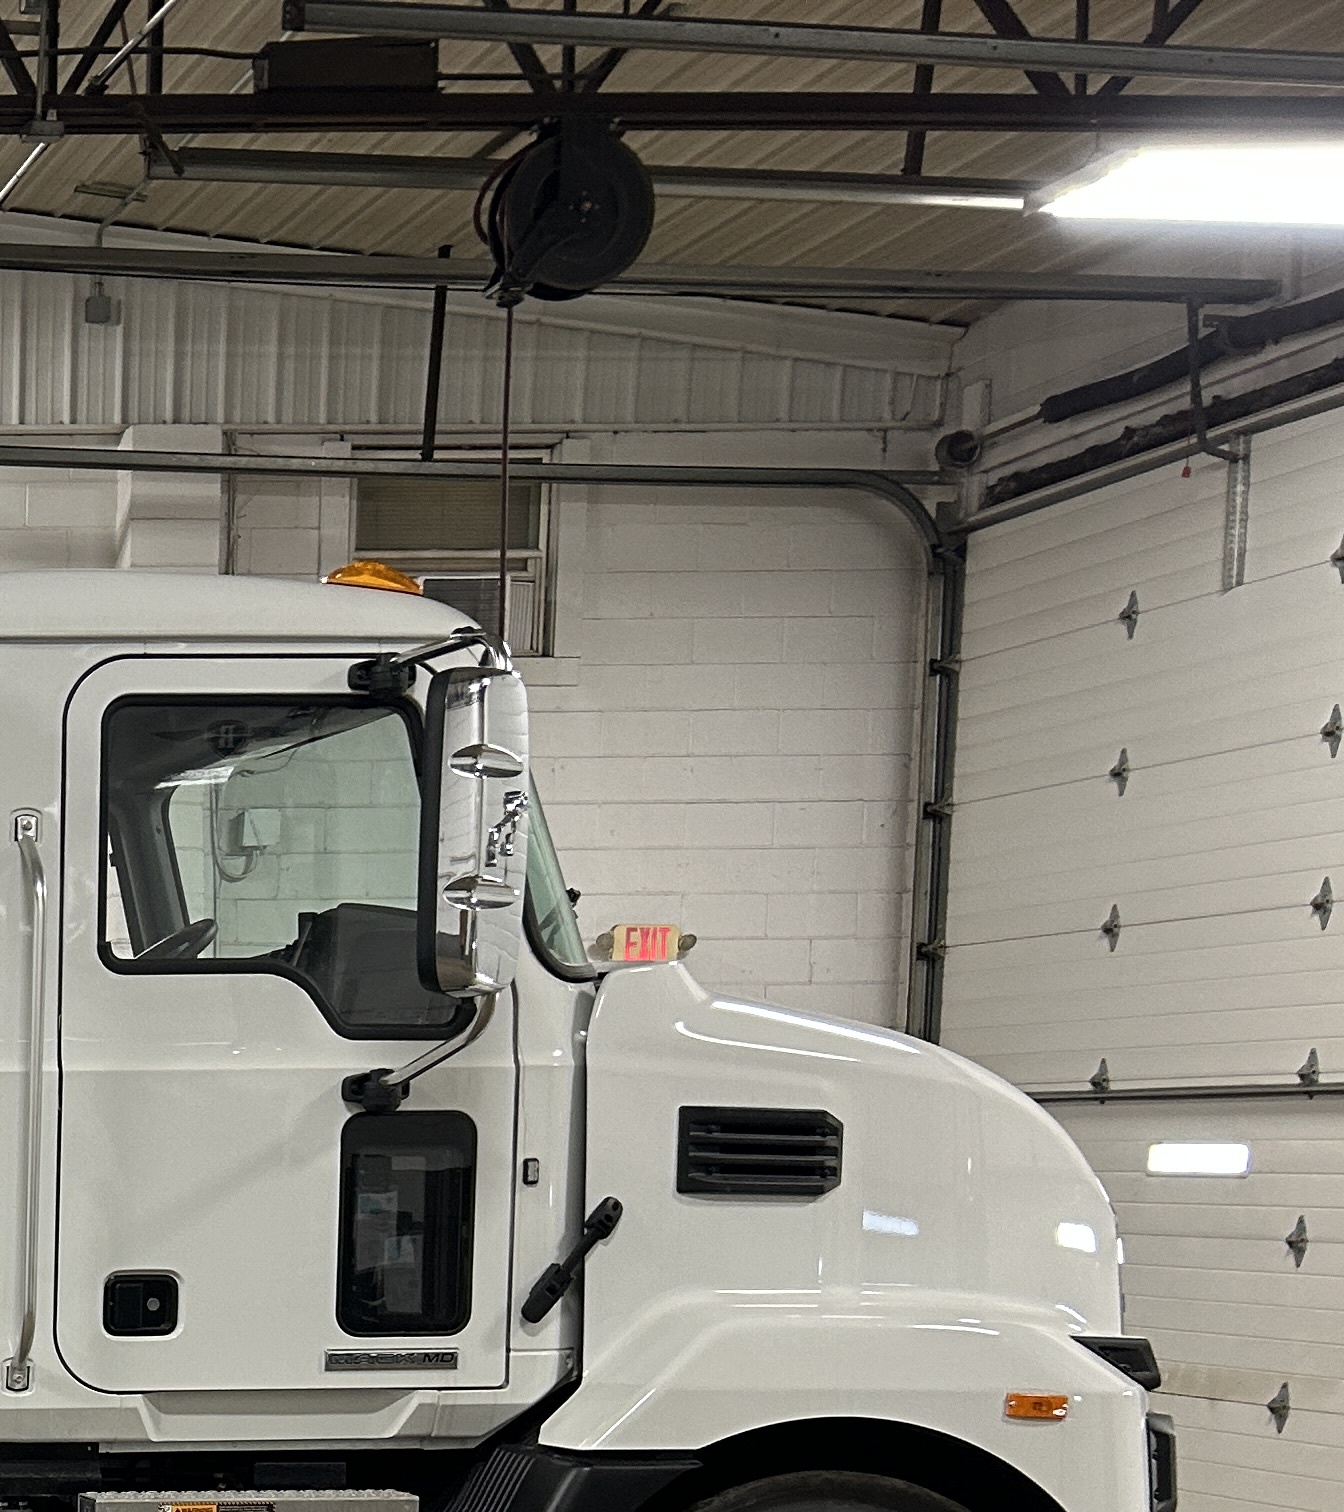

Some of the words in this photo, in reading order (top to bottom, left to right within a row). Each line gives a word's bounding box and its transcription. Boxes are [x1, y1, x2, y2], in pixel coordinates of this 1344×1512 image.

[623, 927, 671, 962] EXIT
[327, 1352, 417, 1365] MACK
[422, 1352, 455, 1364] MD
